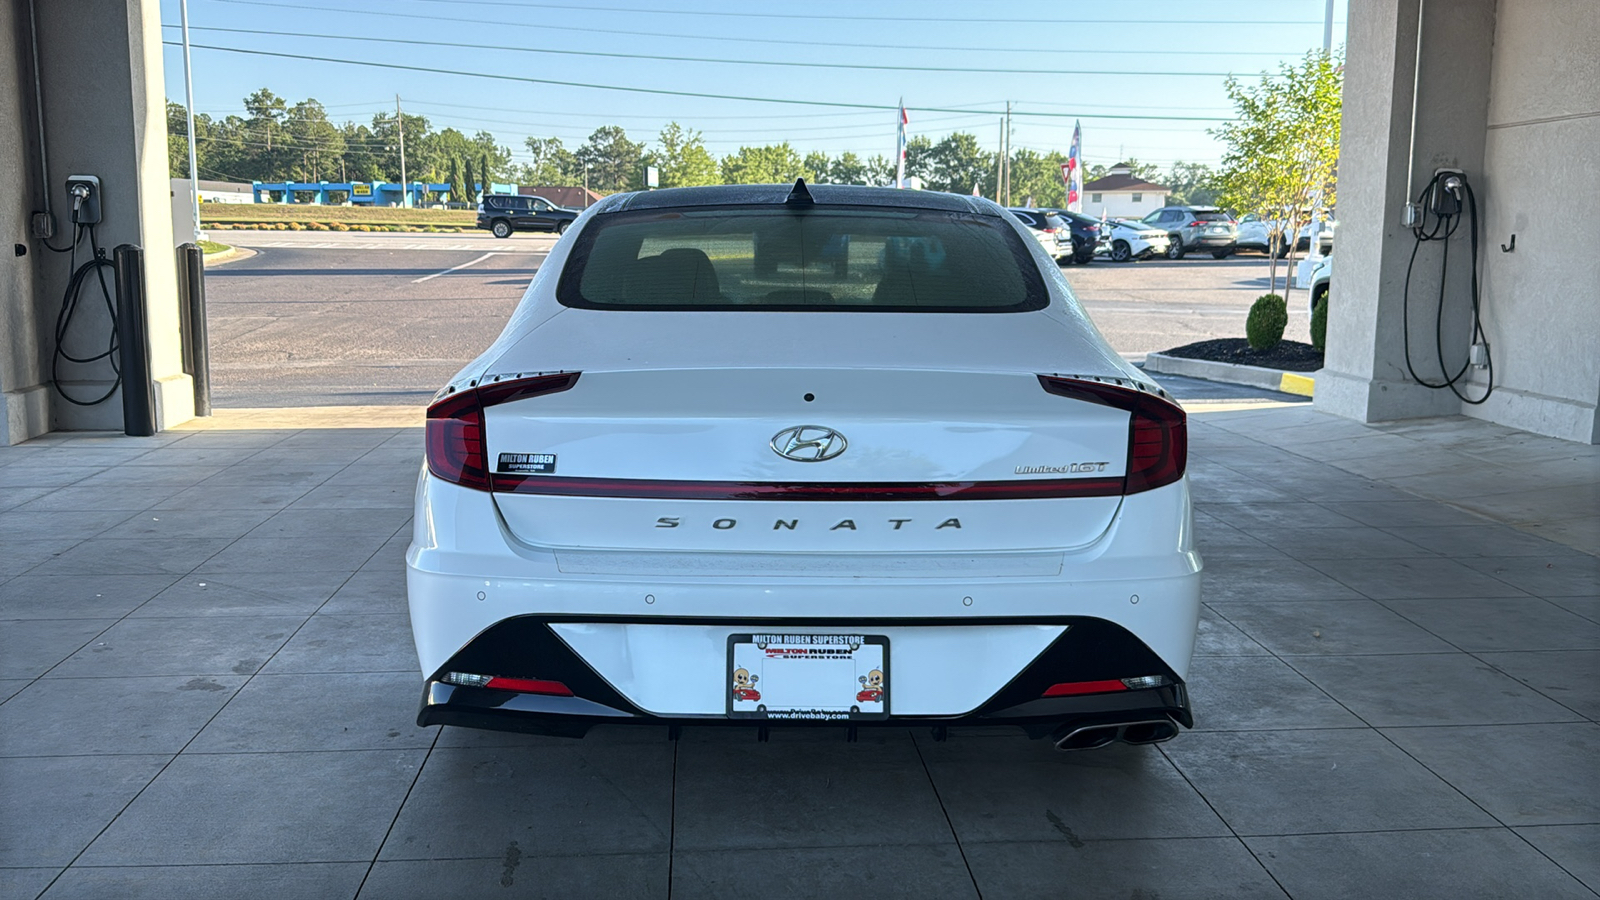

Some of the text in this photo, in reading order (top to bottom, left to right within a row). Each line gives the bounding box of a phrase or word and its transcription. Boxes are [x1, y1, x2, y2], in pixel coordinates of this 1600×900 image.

[500, 454, 554, 463] MILTON RUBEN
[1014, 465, 1068, 474] Limited
[654, 517, 963, 530] SONATA
[752, 634, 865, 645] MILTON RUBEN SUPERSTORE
[767, 712, 849, 721] www.drivebaby.com
